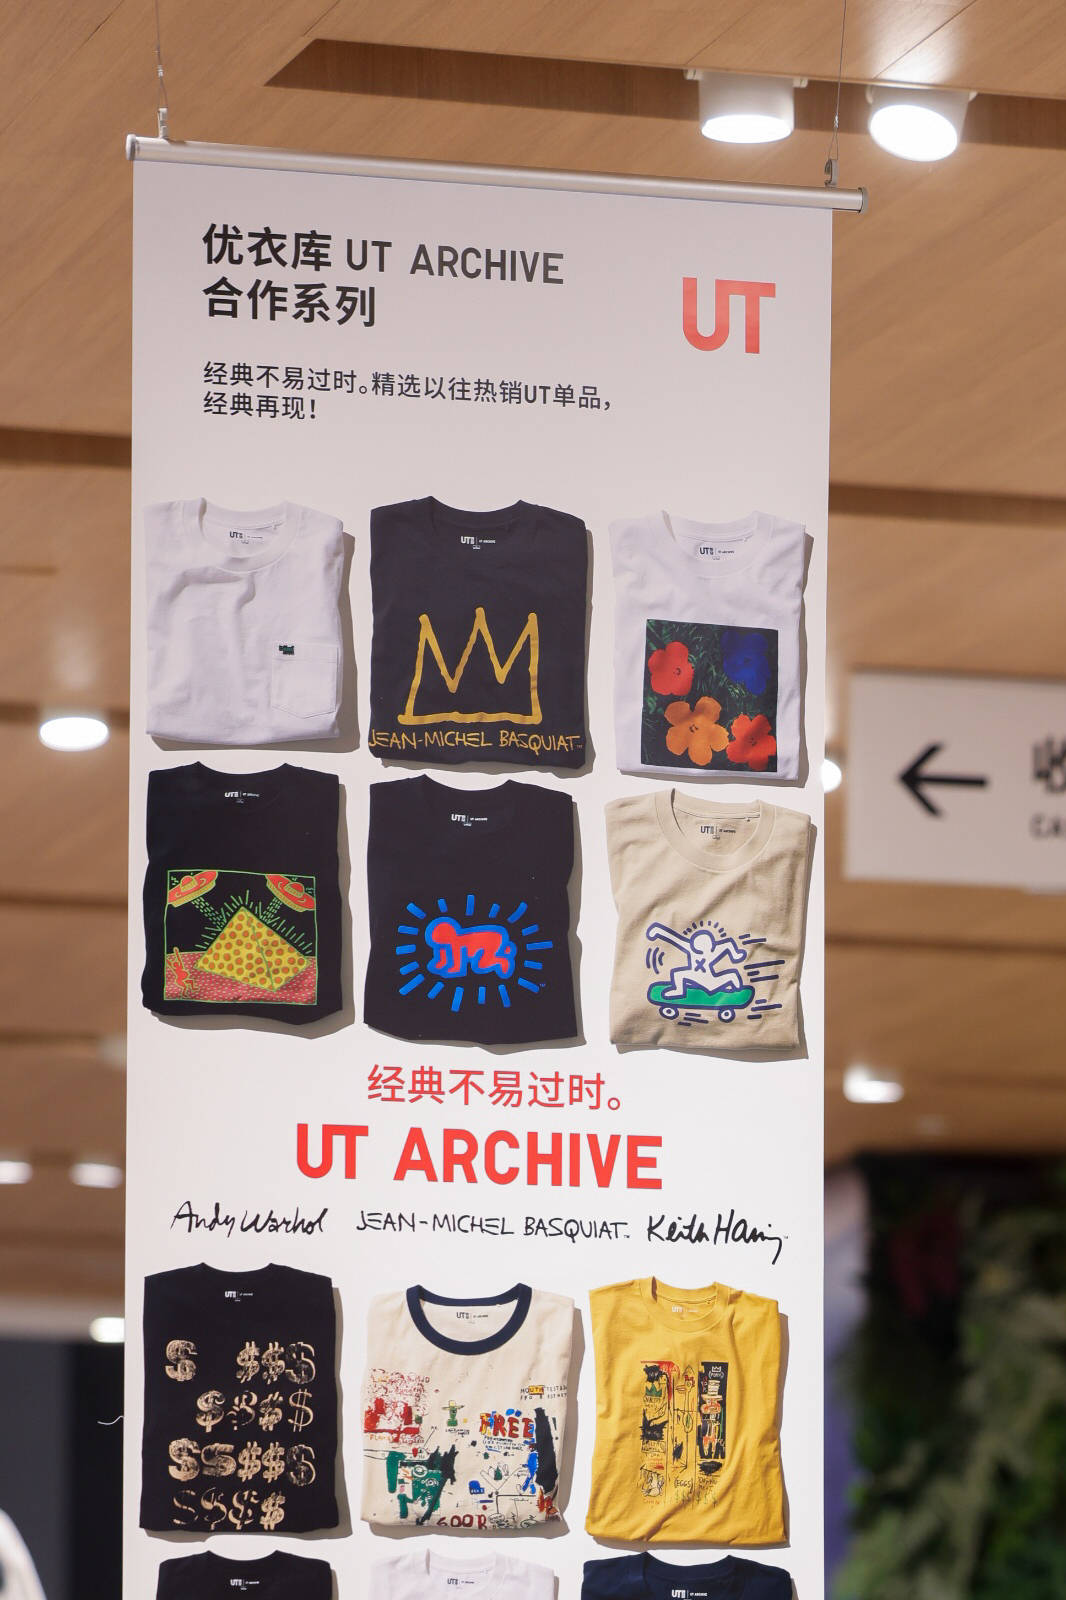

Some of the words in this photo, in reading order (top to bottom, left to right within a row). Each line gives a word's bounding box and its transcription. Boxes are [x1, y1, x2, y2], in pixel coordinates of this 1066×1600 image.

[202, 223, 332, 271] 优衣库
[346, 238, 393, 272] UT
[410, 243, 564, 284] ARCHIVE
[202, 276, 376, 328] 合作系列
[681, 276, 776, 354] UT
[203, 361, 612, 412] 经典不易过时。精选以往热销UT单品，
[203, 391, 316, 419] 经典再现！
[368, 729, 493, 750] JEAN-MICHEL
[367, 1064, 620, 1111] 经典不易过时。
[296, 1123, 369, 1179] UT
[393, 1126, 662, 1190] ARCHIVE
[356, 1210, 514, 1235] JEAN-MICHEL
[479, 1411, 535, 1438] FREE
